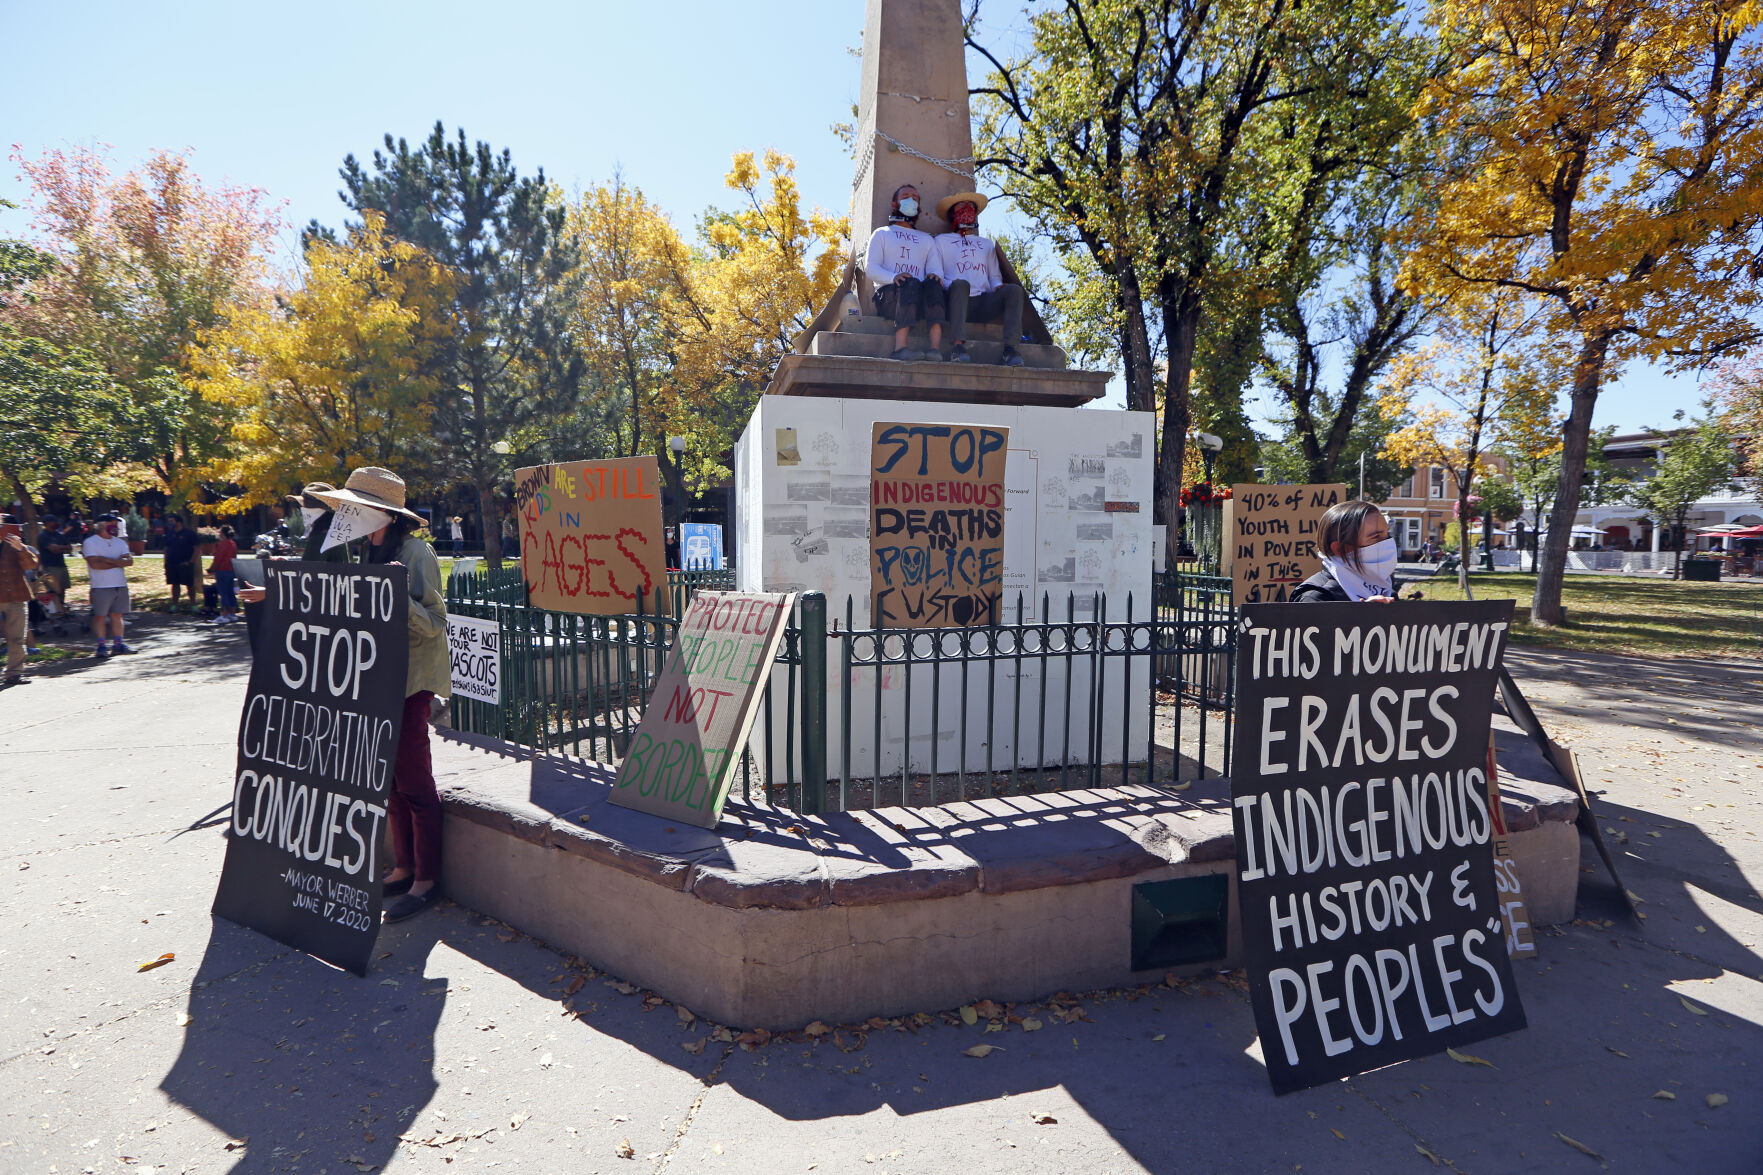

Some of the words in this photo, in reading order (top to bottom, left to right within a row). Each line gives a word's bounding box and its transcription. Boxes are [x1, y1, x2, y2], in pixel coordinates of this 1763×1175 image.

[894, 231, 920, 244] TAKE
[900, 246, 911, 260] IT
[951, 240, 984, 250] TAKE
[961, 249, 976, 258] IT
[894, 262, 920, 276] DOWN
[956, 261, 987, 274] DOWN
[875, 425, 1005, 478] STOP
[516, 465, 550, 511] BROWN
[554, 466, 577, 499] ARE
[582, 467, 655, 502] STILL
[524, 485, 552, 529] KIDS
[559, 511, 580, 528] IN
[874, 479, 1003, 509] INDIGENOUS
[1241, 492, 1280, 512] 40%
[1285, 489, 1303, 511] of
[875, 508, 1002, 542] DEATHS
[929, 532, 957, 551] IN
[1238, 516, 1289, 536] YOUTH
[523, 527, 652, 600] CAGES
[1237, 542, 1254, 559] IN
[318, 573, 362, 619] TIME
[365, 576, 394, 622] TO
[684, 596, 793, 638] PROTECT
[877, 587, 1003, 627] CUSTODY
[450, 637, 471, 652] YOUR
[459, 626, 478, 643] ARE
[481, 631, 499, 651] NOT
[1333, 621, 1509, 677] MONUMENT
[280, 622, 377, 700] STOP
[670, 634, 765, 685] PEOPLE
[664, 685, 735, 734] NOT
[243, 694, 393, 792] CELEBRATING
[1260, 685, 1460, 776] ERASES
[618, 732, 740, 813] BORDERS
[1234, 767, 1491, 882] INDIGENOUS
[292, 893, 319, 914] JUNE
[337, 909, 371, 932] 2020
[328, 879, 369, 912] WEBBER
[1269, 870, 1434, 952] HISTORY
[1450, 860, 1477, 911] &
